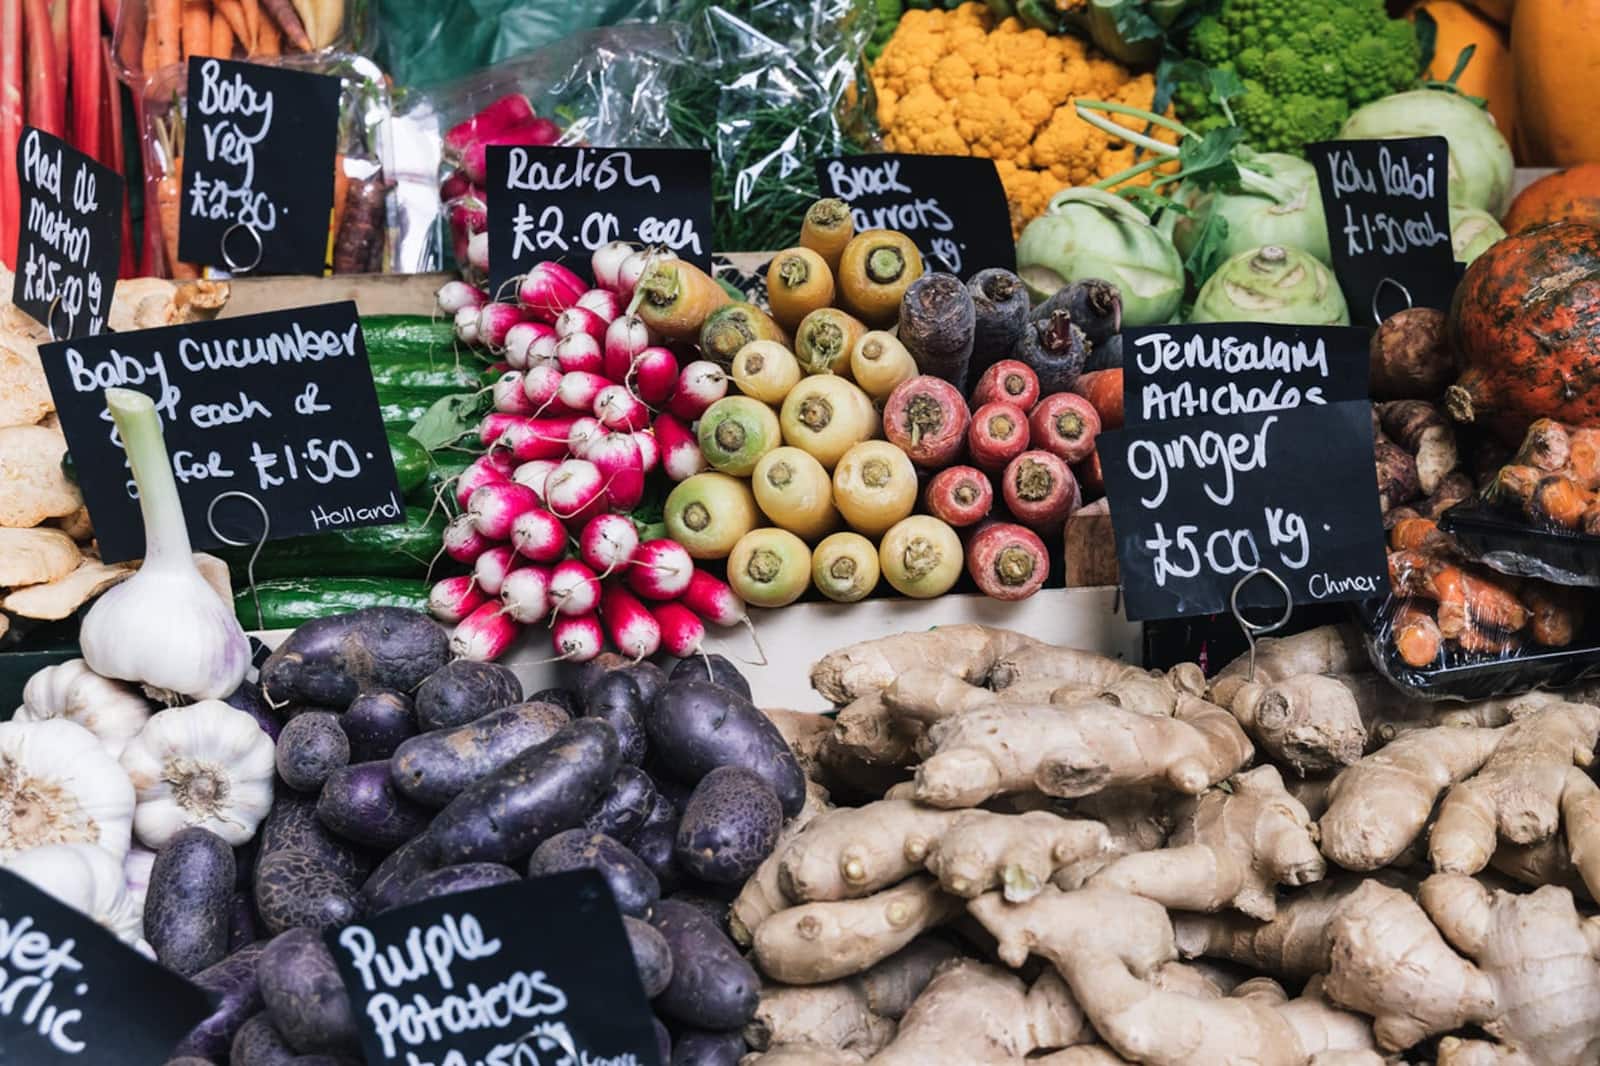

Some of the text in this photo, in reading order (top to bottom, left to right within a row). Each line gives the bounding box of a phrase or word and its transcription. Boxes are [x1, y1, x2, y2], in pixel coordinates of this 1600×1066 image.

[199, 59, 273, 144] Baby
[24, 130, 98, 214] Pied de
[506, 147, 661, 194] Radish
[827, 160, 912, 201] Black
[852, 198, 953, 233] arrots
[190, 392, 272, 428] each
[310, 490, 402, 531] Holland
[339, 912, 502, 990] Purple
[366, 970, 568, 1058] Potatoes
